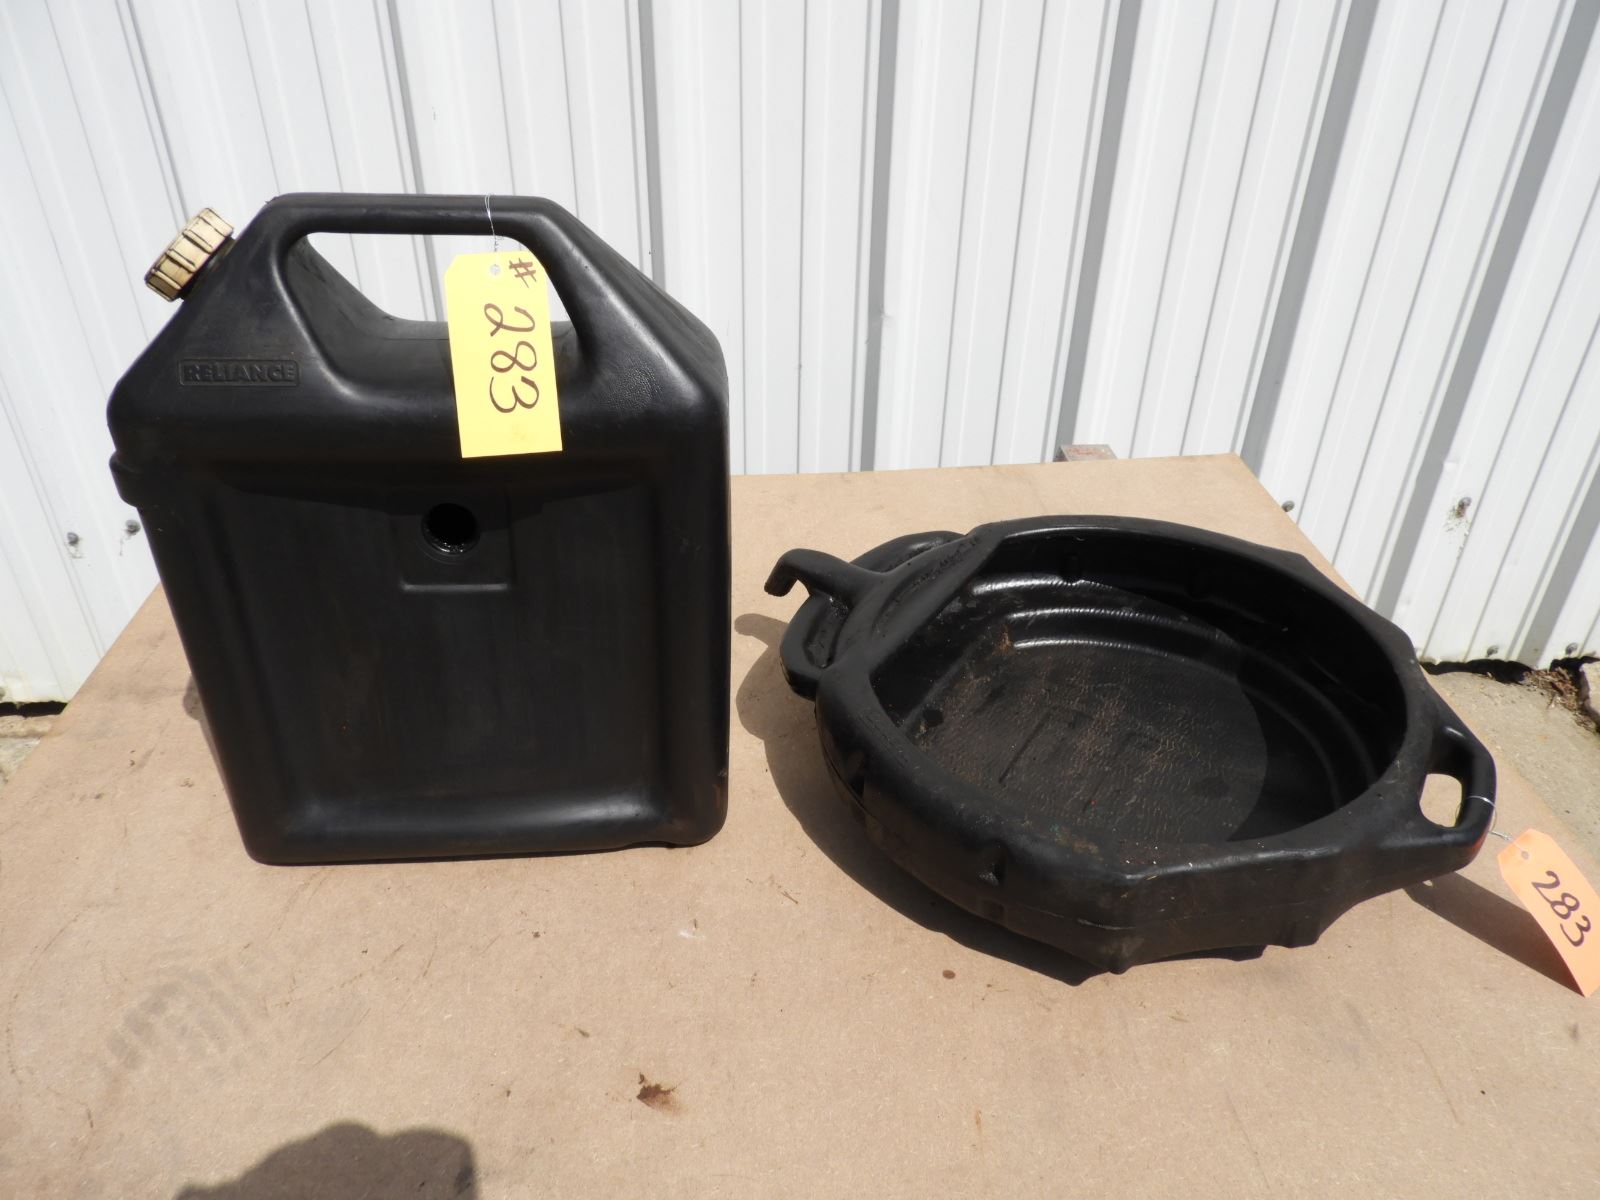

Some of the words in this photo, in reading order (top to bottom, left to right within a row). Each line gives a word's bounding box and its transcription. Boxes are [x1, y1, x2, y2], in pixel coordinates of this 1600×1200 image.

[183, 363, 296, 382] RELIANCE
[483, 302, 540, 413] 283
[1531, 870, 1592, 947] 283
